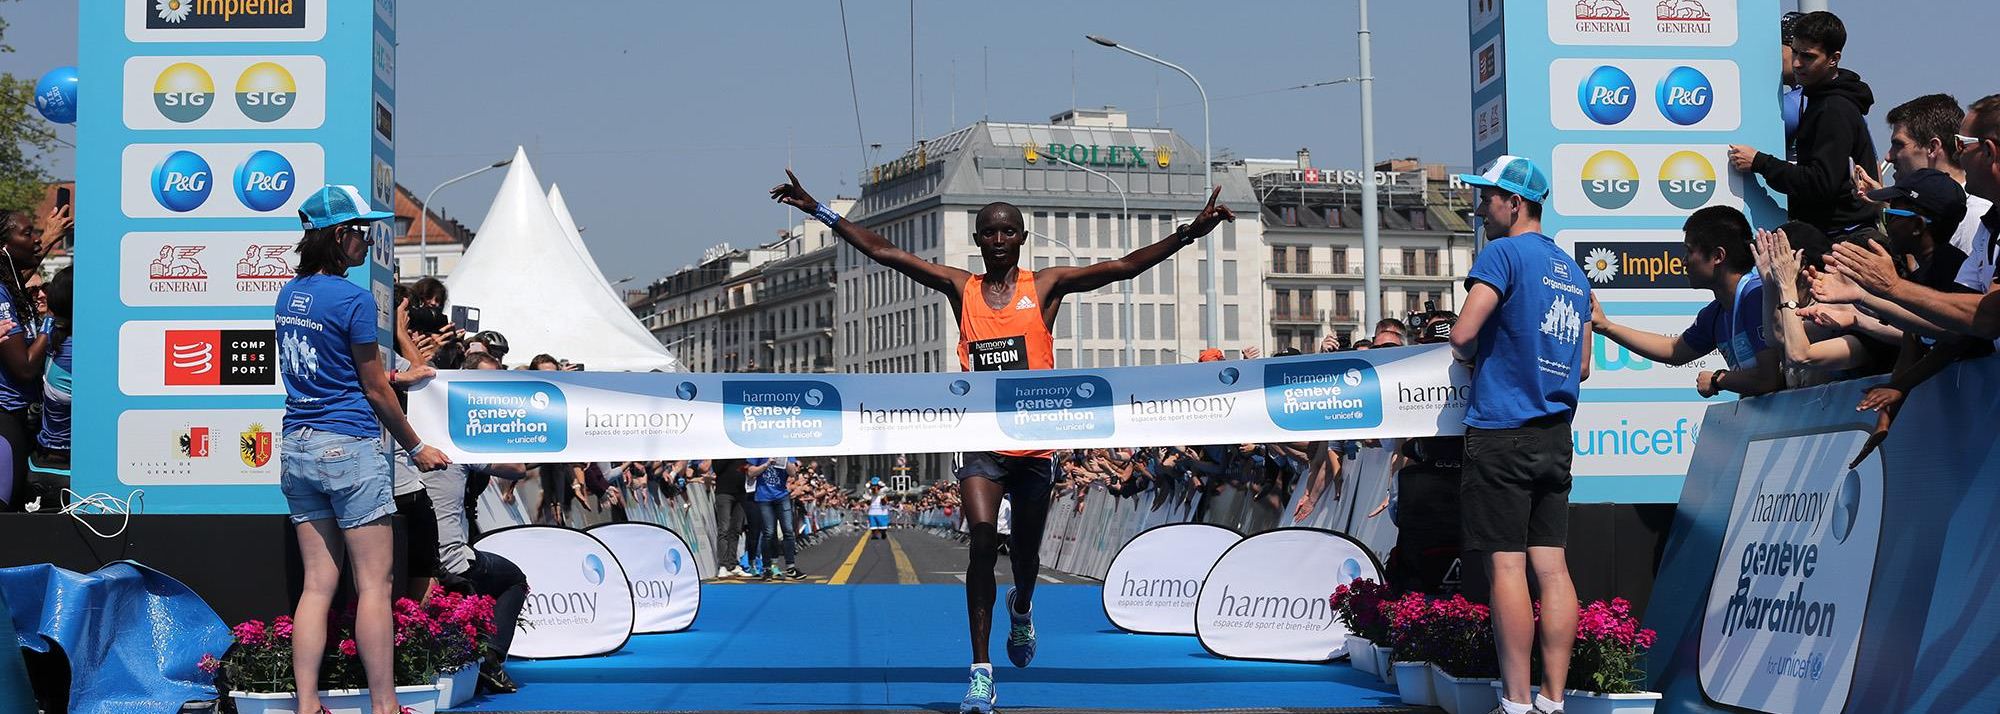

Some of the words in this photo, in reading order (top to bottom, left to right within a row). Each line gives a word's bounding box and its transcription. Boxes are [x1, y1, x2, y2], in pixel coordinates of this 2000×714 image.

[1576, 22, 1630, 33] GENERALI
[1657, 23, 1711, 33] GENERALI
[165, 92, 205, 106] SIG
[246, 92, 286, 106] SIG
[1590, 86, 1630, 105] P&G
[1667, 86, 1707, 106] P&G
[1047, 143, 1149, 167] ROLEX
[164, 171, 206, 191] P&G
[246, 171, 288, 191] P&G
[1592, 179, 1630, 193] SIG
[1669, 179, 1707, 193] SIG
[1623, 251, 1688, 282] Imple
[149, 281, 207, 292] GENERALI
[236, 281, 284, 292] GENERA
[1542, 276, 1584, 296] Organisation
[276, 314, 323, 331] Organisation
[231, 341, 266, 349] COMP
[980, 350, 1019, 365] YEGON
[1284, 373, 1339, 387] harmony
[468, 394, 527, 406] harmony
[743, 391, 800, 405] harmony
[1015, 387, 1072, 397] harmony
[1398, 382, 1471, 402] harmo
[1130, 394, 1236, 418] harmony
[1284, 396, 1363, 414] marathon
[585, 407, 694, 434] harmony
[860, 402, 967, 428] harmony
[1014, 409, 1094, 426] marathon
[466, 419, 547, 436] marathon
[741, 416, 822, 433] marathon
[1573, 418, 1687, 455] unicef
[1752, 480, 1830, 537] harmony
[1120, 570, 1199, 598] harmo
[526, 591, 597, 623] mony
[1722, 582, 1836, 637] marathon
[1213, 619, 1242, 628] espaces
[1244, 619, 1253, 628] de
[1255, 620, 1275, 630] sport
[1276, 620, 1284, 629] et
[1778, 650, 1813, 678] unicef
